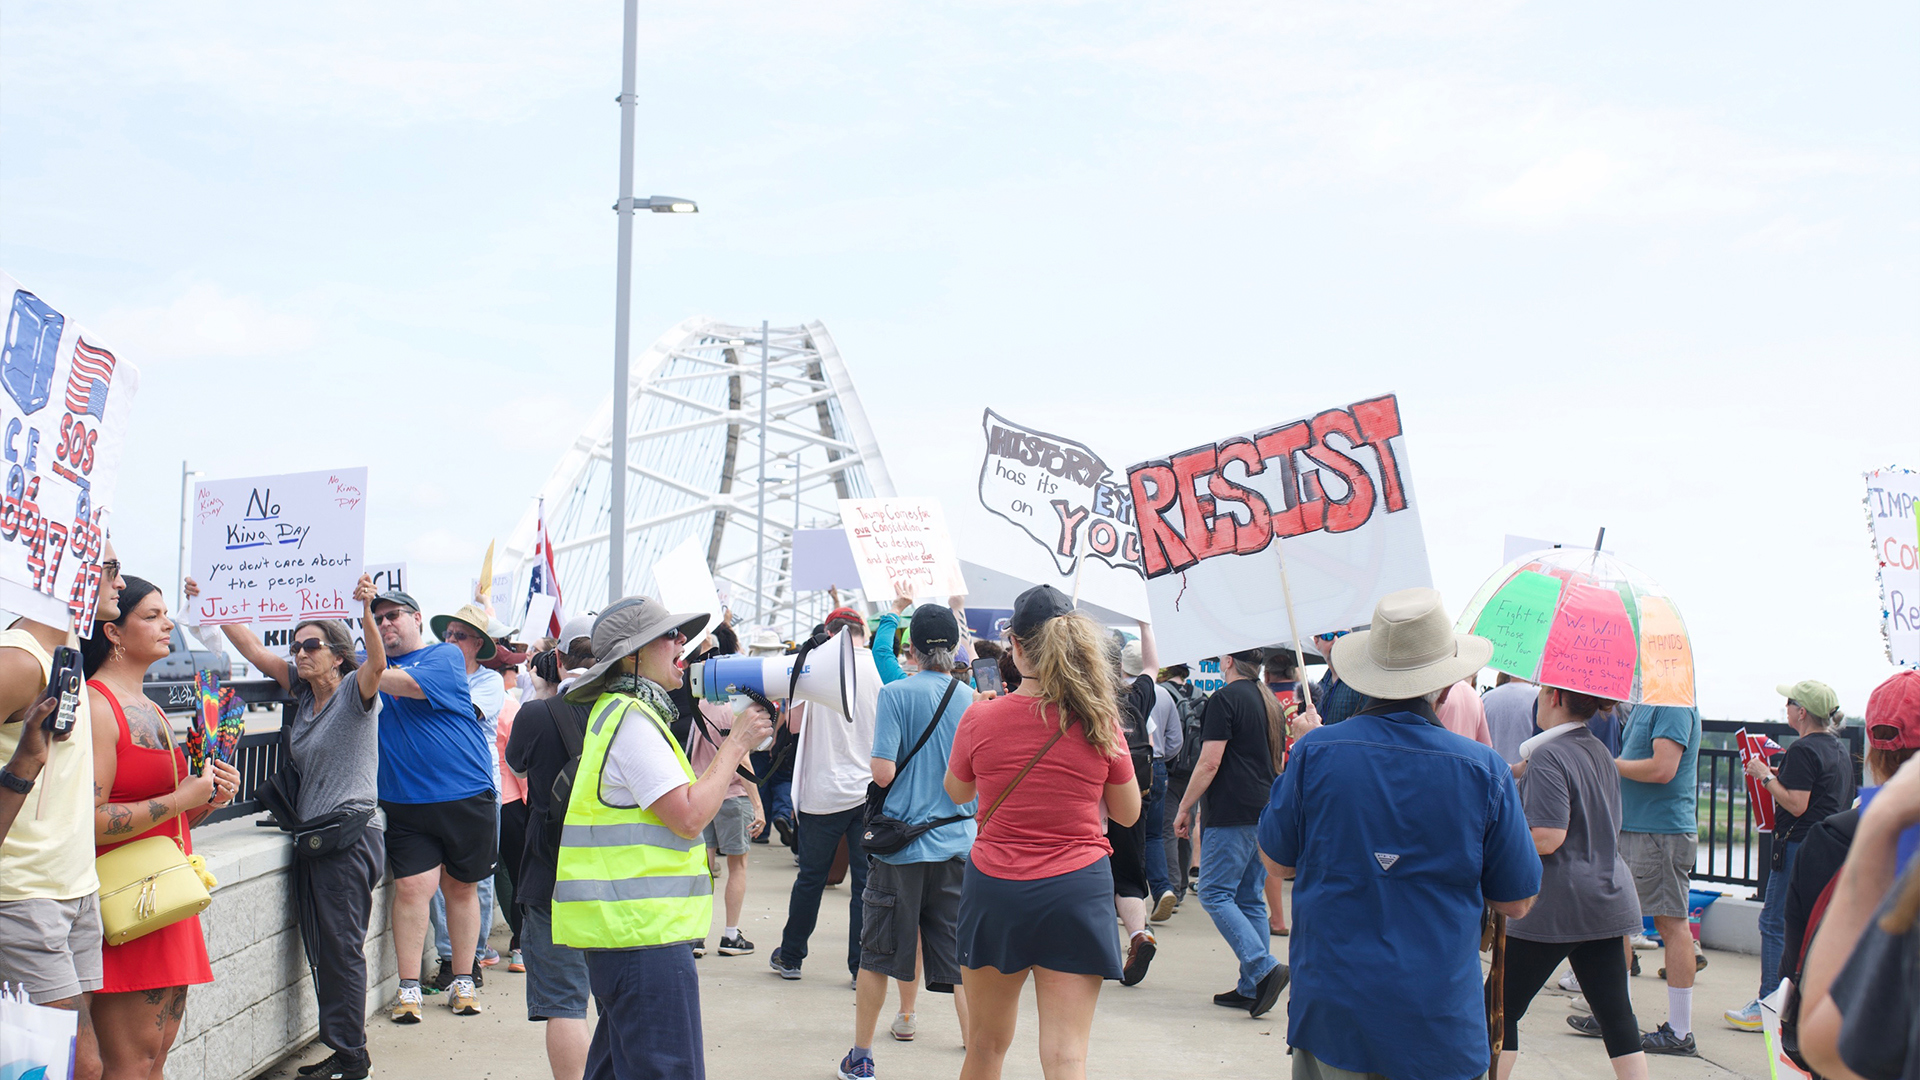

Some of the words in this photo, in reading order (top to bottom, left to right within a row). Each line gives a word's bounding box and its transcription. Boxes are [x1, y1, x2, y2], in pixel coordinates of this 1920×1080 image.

[4, 417, 40, 472] CE
[56, 412, 98, 476] SOS
[989, 425, 1107, 488] HISTORY
[328, 475, 339, 485] No
[1127, 393, 1409, 579] RESIST
[197, 488, 210, 500] No
[246, 488, 280, 518] No
[995, 460, 1027, 486] has
[1036, 472, 1059, 495] its
[1091, 483, 1135, 527] EY
[856, 507, 885, 522] Trump
[1011, 500, 1033, 517] on
[854, 526, 871, 535] OUR
[872, 521, 921, 534] Constitution
[874, 536, 888, 548] to
[891, 535, 925, 554] destroy
[867, 554, 881, 564] and
[885, 552, 919, 565] dismantle
[209, 563, 233, 581] you
[239, 557, 269, 571] don't
[228, 577, 257, 590] the
[268, 574, 316, 590] people
[201, 597, 250, 618] Just
[258, 598, 288, 612] the
[295, 588, 344, 611] Rich
[1496, 600, 1532, 625] Fight
[1537, 612, 1548, 623] for
[1890, 590, 1920, 631] Re
[1497, 625, 1523, 639] Those
[1565, 613, 1586, 631] We
[1593, 617, 1621, 636] Will
[1515, 642, 1531, 655] Your
[1573, 635, 1612, 650] NOT
[1648, 634, 1682, 650] HANDS
[1551, 647, 1578, 662] Stop
[1586, 656, 1609, 666] until
[1616, 659, 1630, 669] the
[1655, 658, 1677, 677] OFF
[787, 665, 810, 675] PLE
[1557, 661, 1594, 678] Orange
